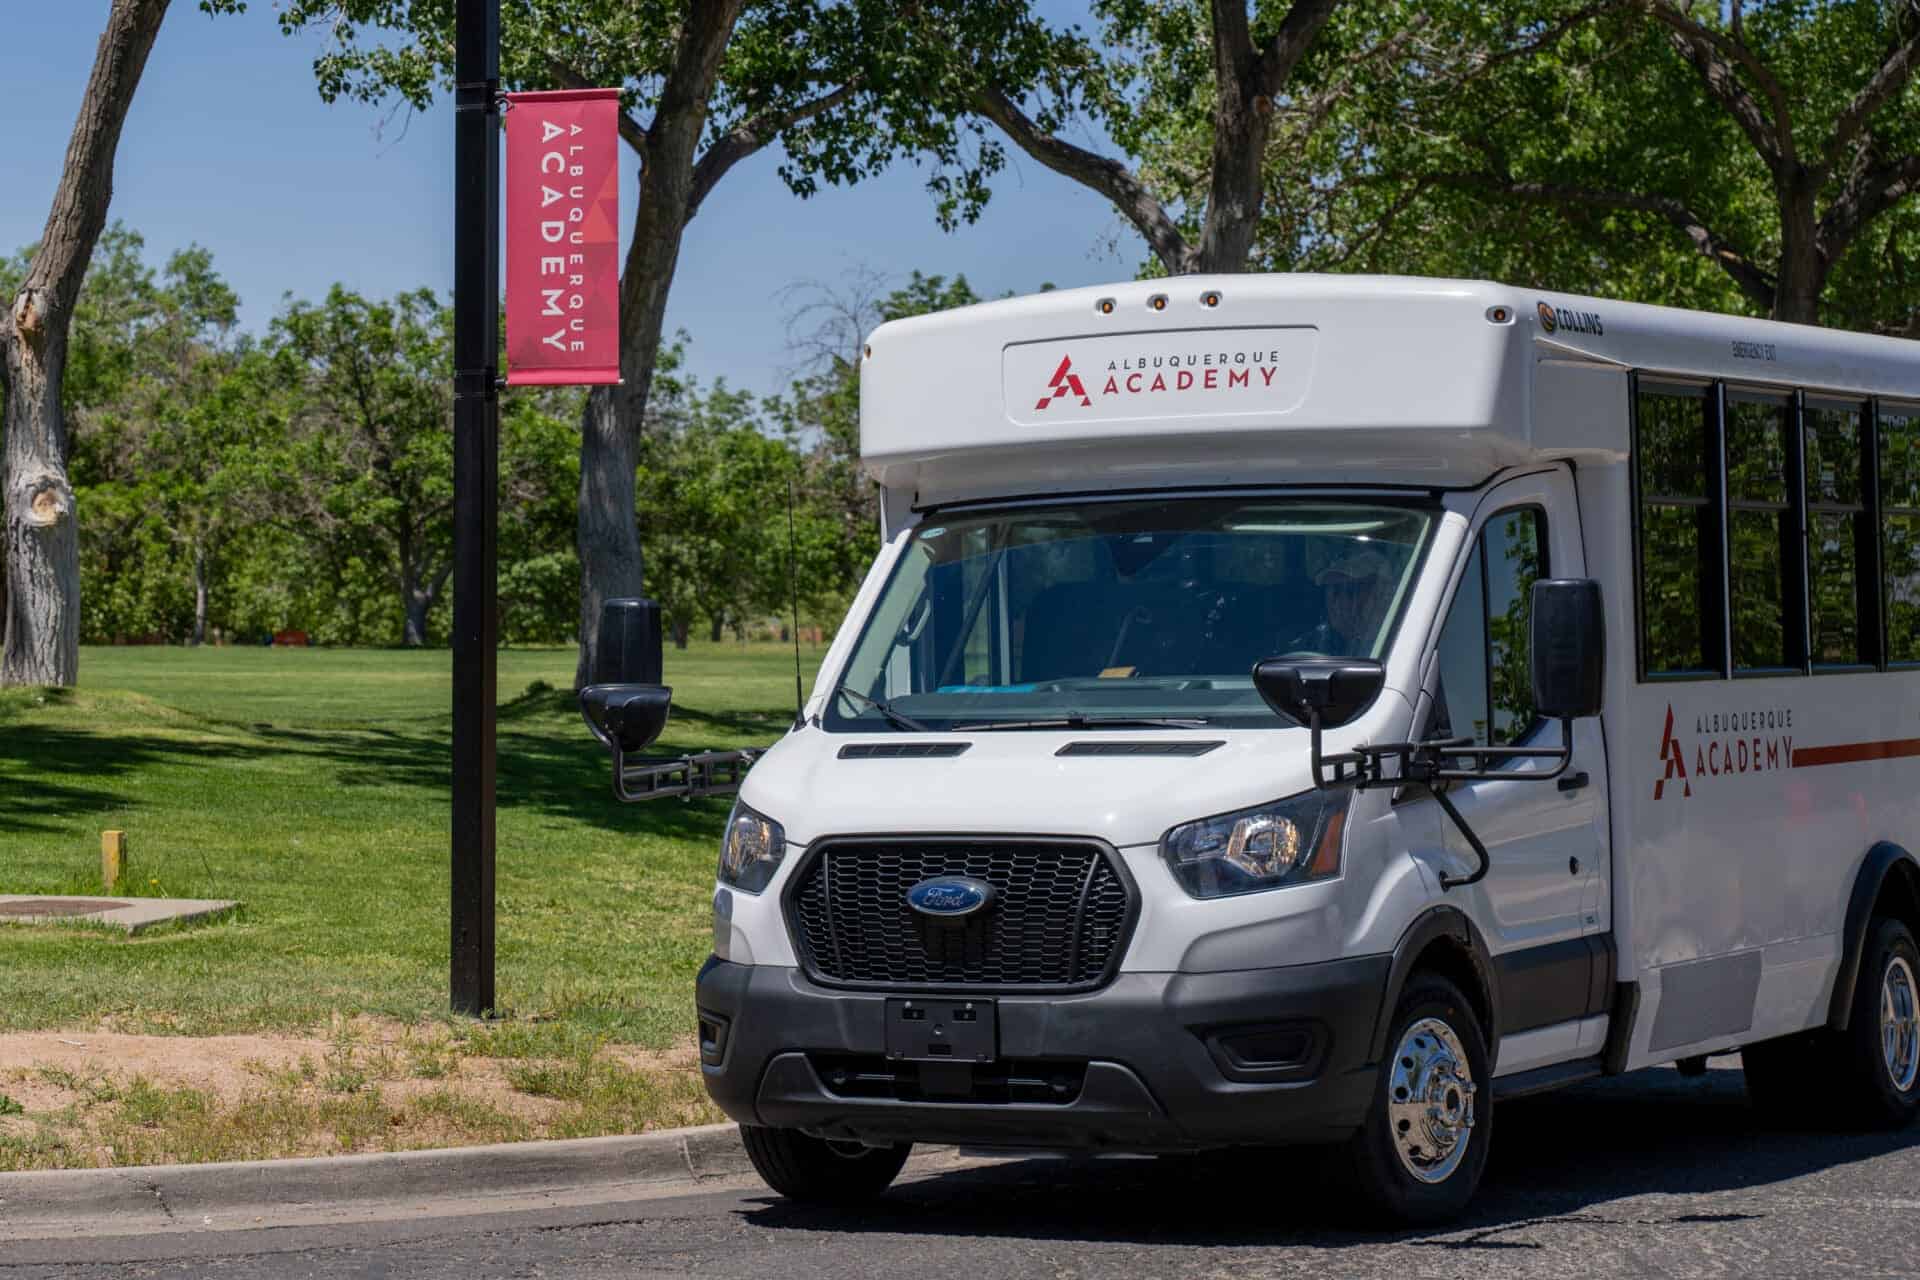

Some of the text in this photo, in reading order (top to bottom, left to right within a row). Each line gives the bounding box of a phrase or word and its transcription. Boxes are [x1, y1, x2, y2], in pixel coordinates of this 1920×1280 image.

[541, 120, 566, 352] ACADEMY
[569, 123, 584, 352] ALBUQUERQUE
[1556, 308, 1603, 336] COLLINS
[1108, 351, 1279, 370] ALBUQUERQUE
[1103, 366, 1277, 395] ACADEMY
[1696, 709, 1793, 733] ALBUQUERQUE
[1696, 736, 1793, 777] ACADEMY
[922, 887, 965, 906] Ford
